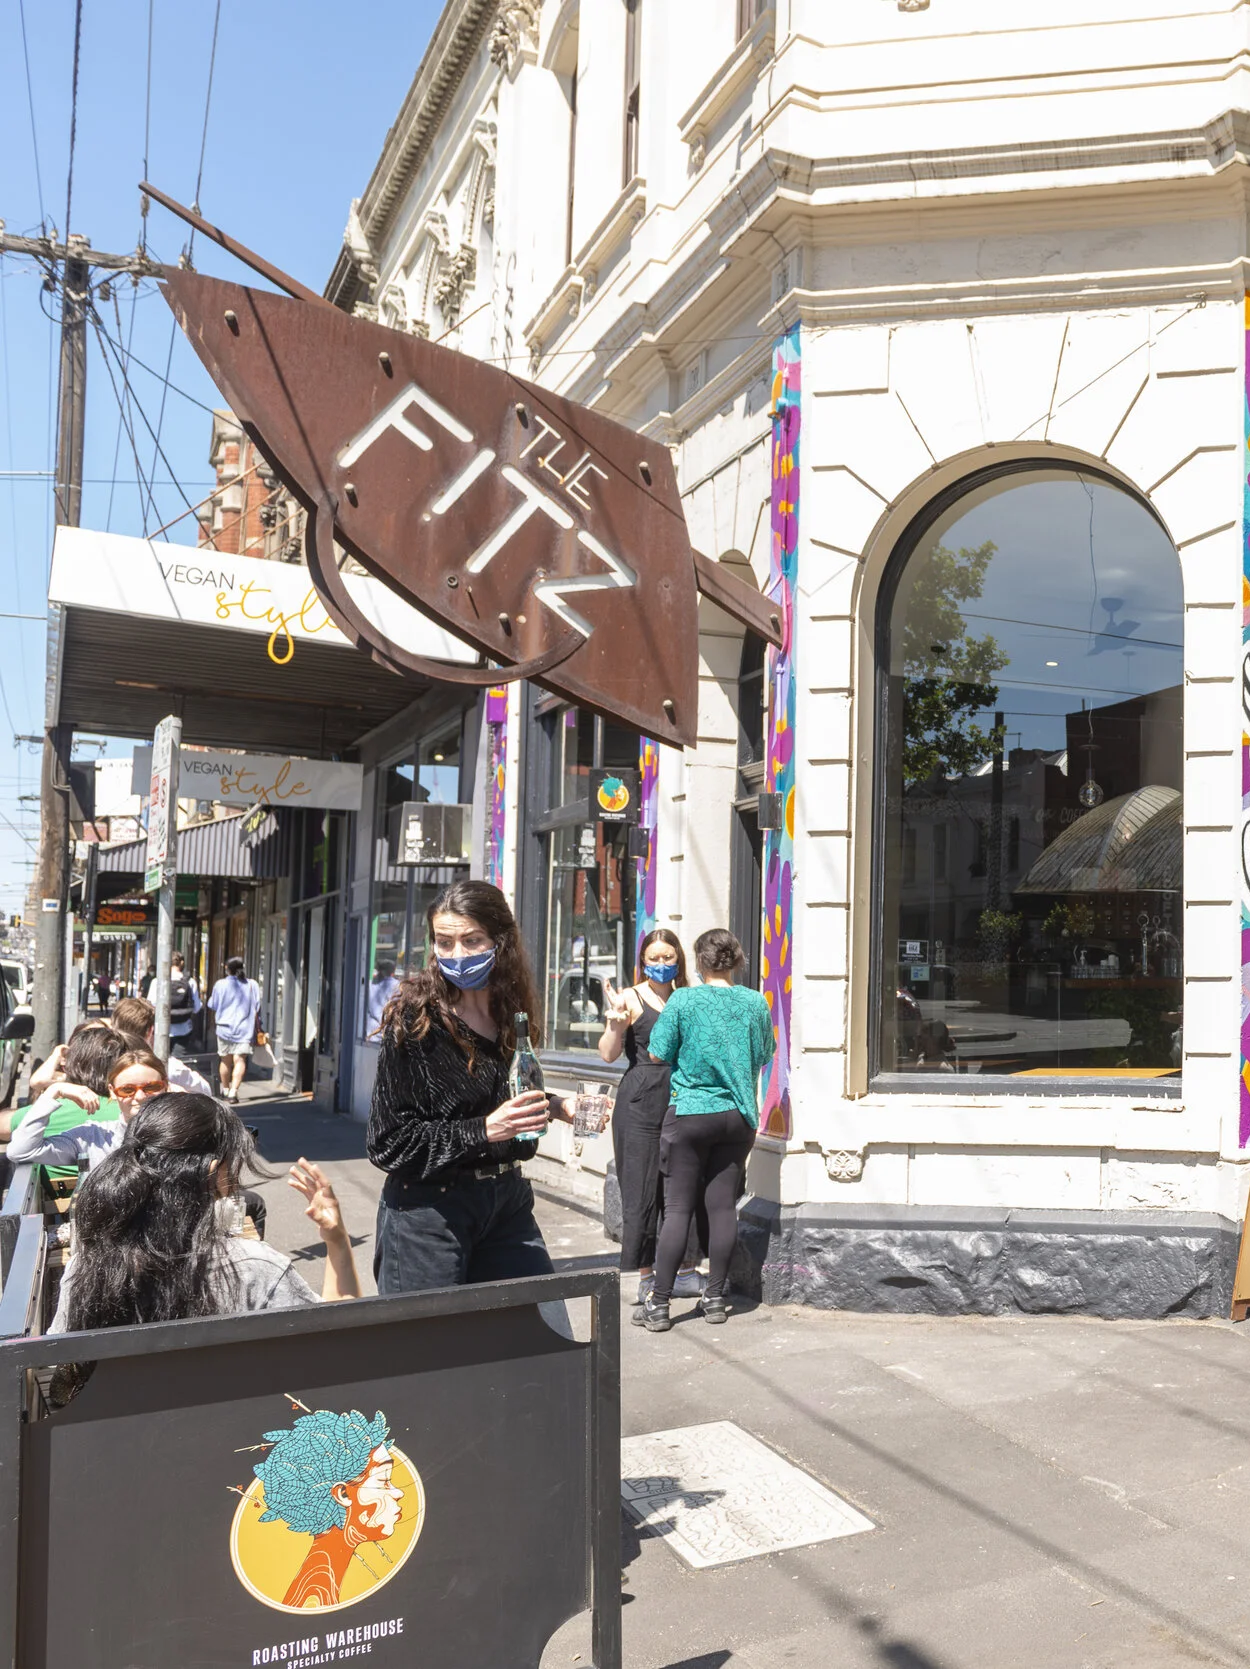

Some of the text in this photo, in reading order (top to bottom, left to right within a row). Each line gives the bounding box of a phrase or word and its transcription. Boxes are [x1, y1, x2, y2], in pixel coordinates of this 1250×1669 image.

[337, 382, 638, 638] FITZ
[160, 562, 234, 590] VEGAN
[216, 580, 339, 664] styl
[184, 761, 232, 776] VEGAN
[220, 761, 311, 804] style
[252, 1618, 404, 1666] ROASTING WAREHOUSE
[287, 1643, 372, 1669] SPECIALTY COFFEE
